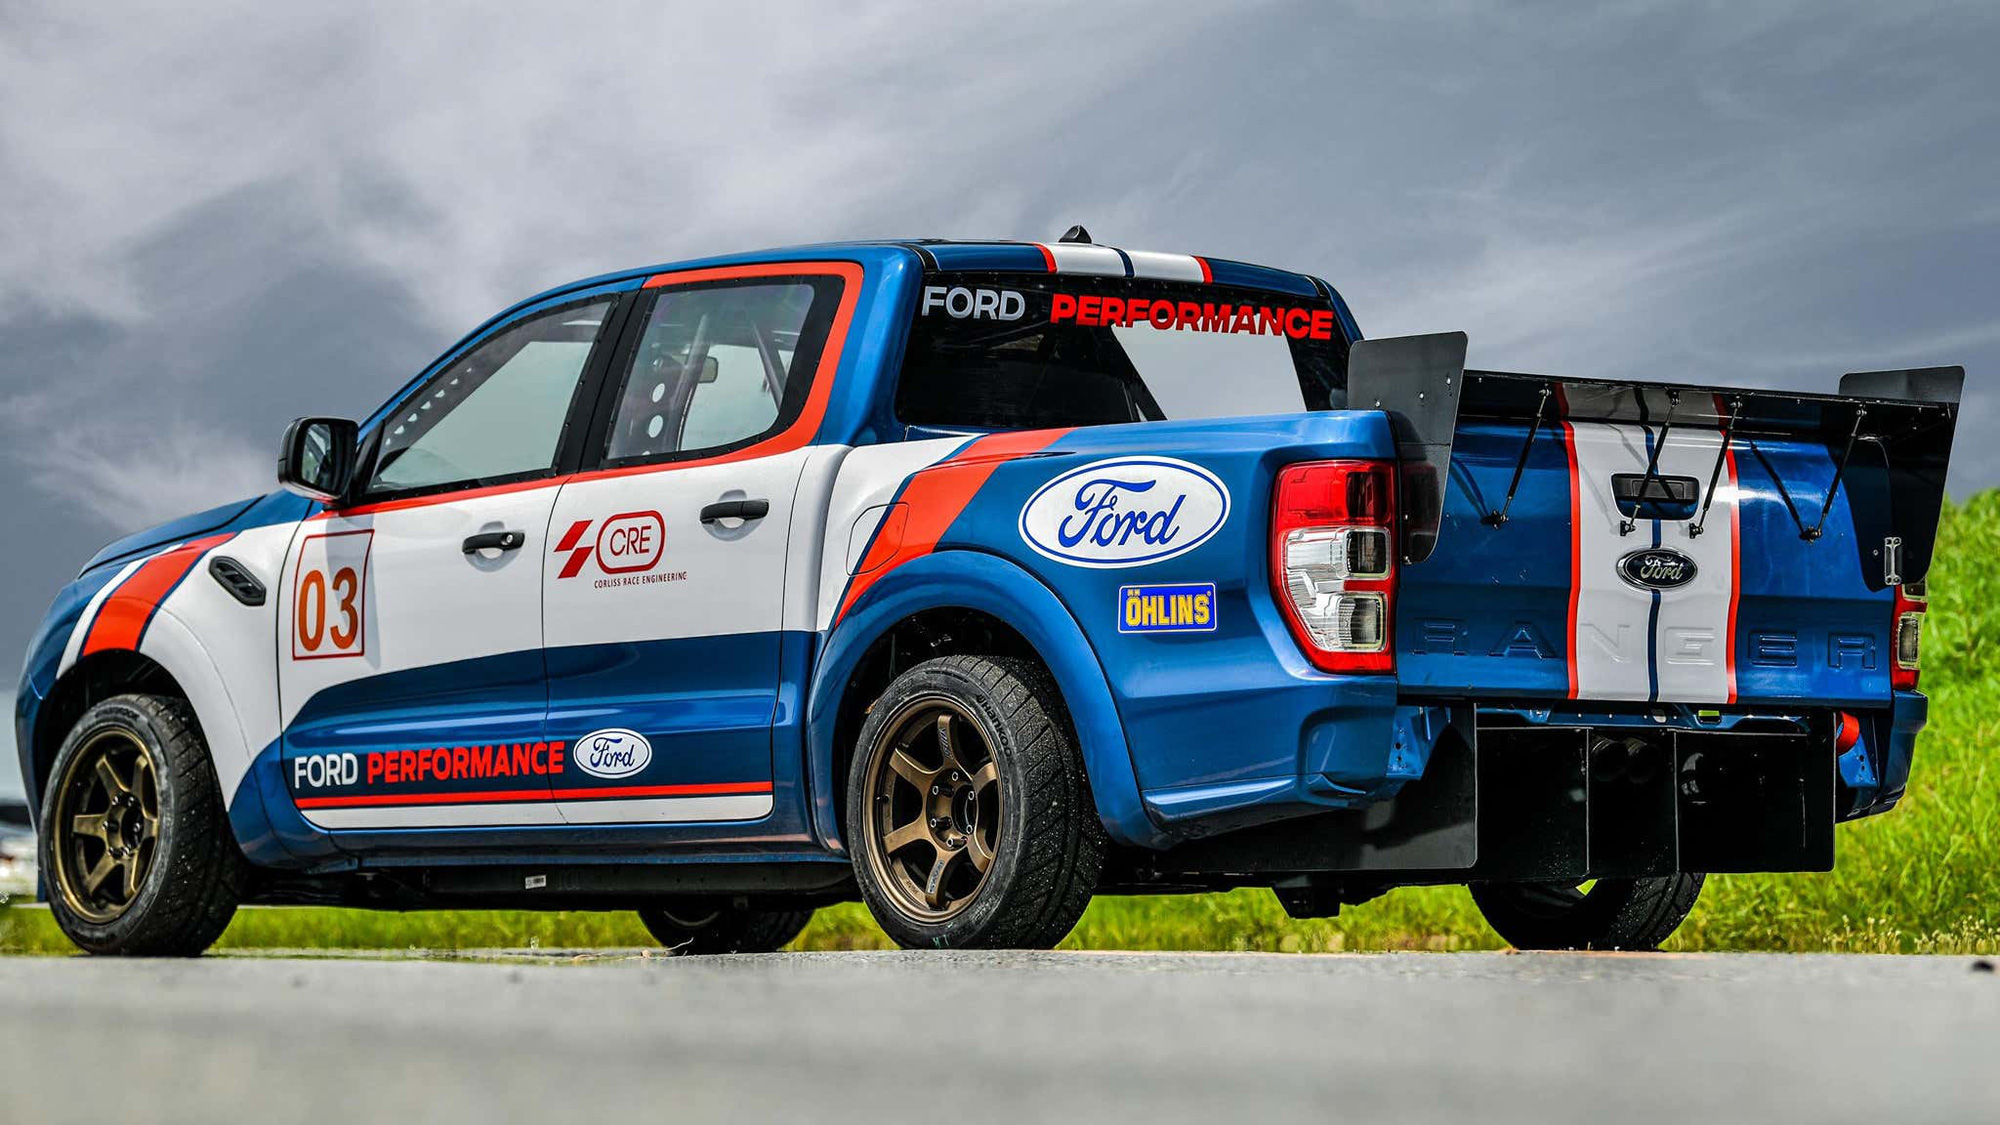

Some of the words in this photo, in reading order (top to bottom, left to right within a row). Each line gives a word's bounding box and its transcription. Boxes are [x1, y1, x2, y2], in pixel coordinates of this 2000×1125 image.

[921, 286, 1026, 321] FORD
[1049, 293, 1335, 341] PERFORMANCE
[1058, 478, 1187, 548] Ford
[609, 525, 652, 557] CRE
[594, 578, 621, 589] CORLISS
[623, 576, 640, 587] RACE
[642, 571, 688, 585] ENGINEERING
[1640, 554, 1685, 580] Ford
[298, 566, 359, 652] 03
[1124, 588, 1212, 627] ÖHLINS
[1410, 617, 1878, 671] RANGER
[294, 752, 359, 789] FORD
[367, 740, 565, 785] PERFORMANCE
[589, 736, 636, 769] Ford
